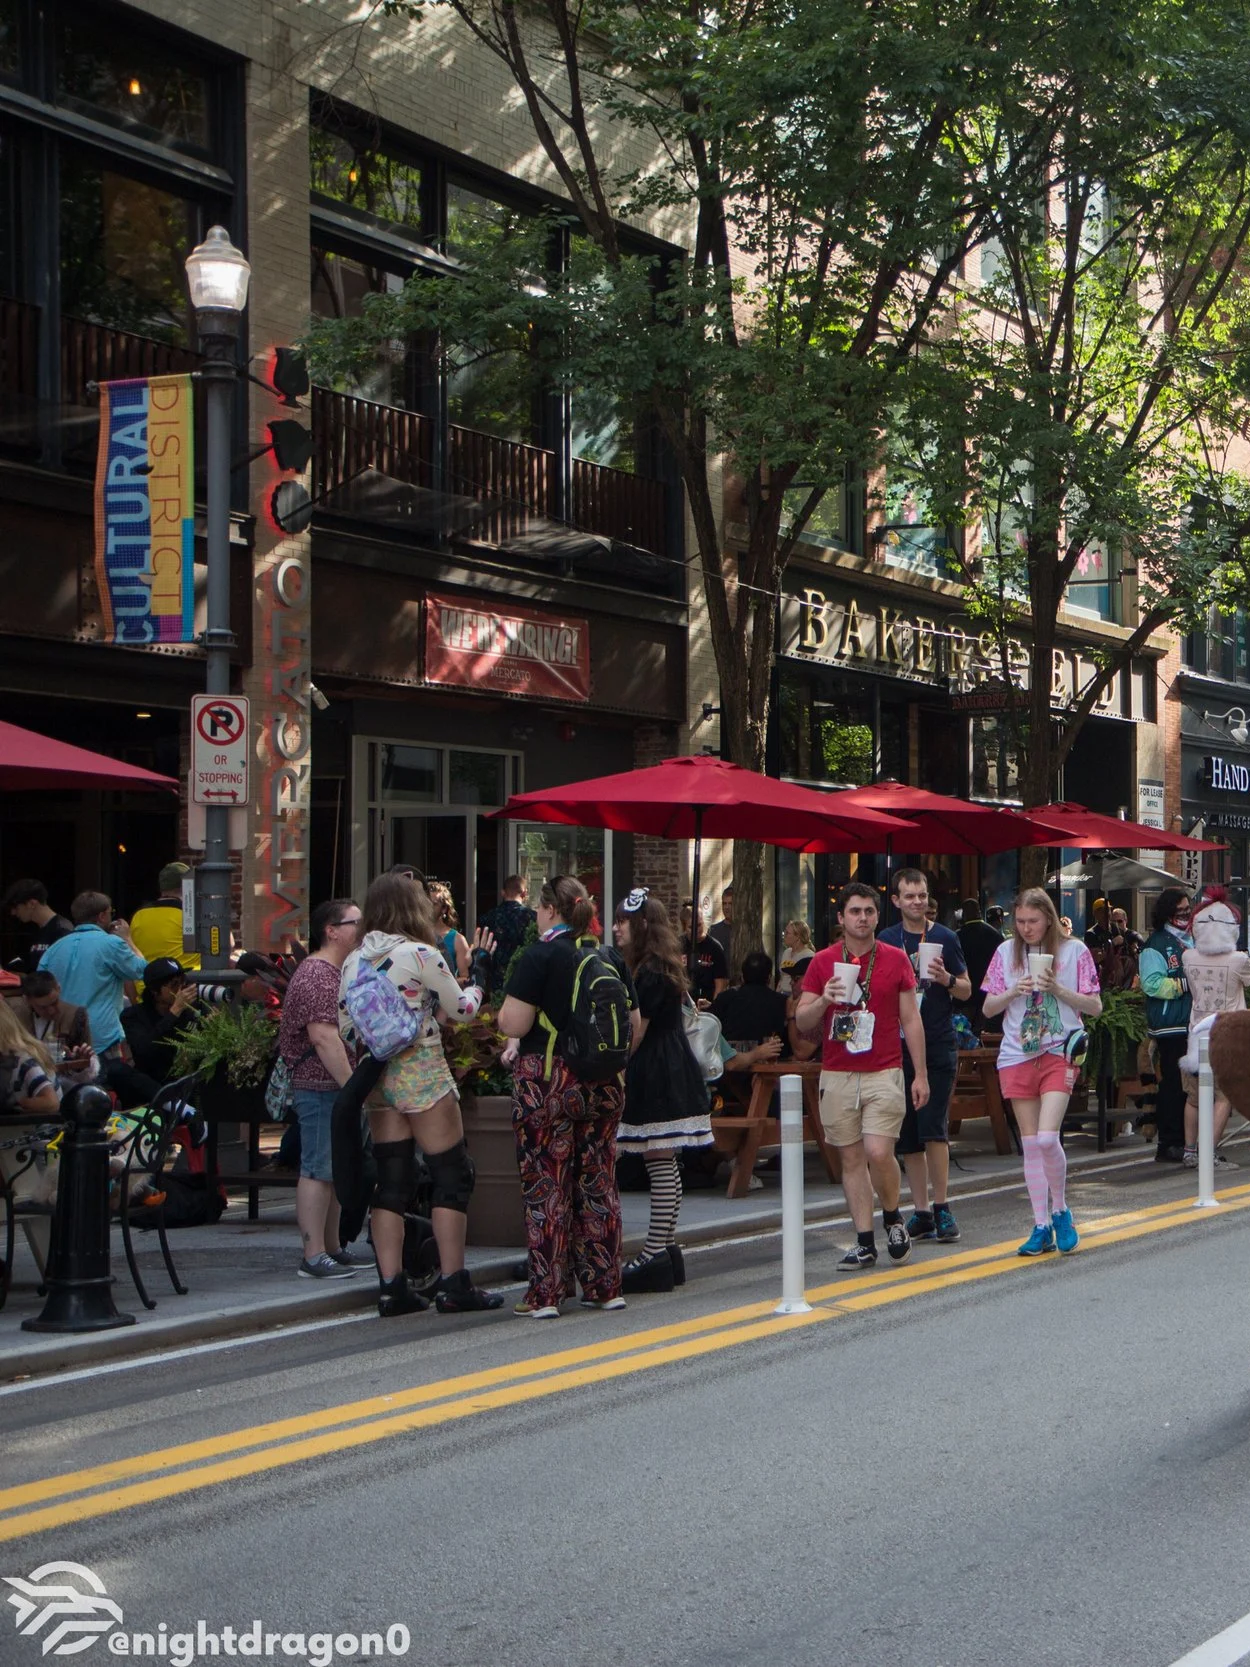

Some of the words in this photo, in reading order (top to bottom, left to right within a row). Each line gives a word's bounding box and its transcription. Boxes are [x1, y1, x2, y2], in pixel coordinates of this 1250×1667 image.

[151, 384, 181, 608] DISTRICT
[107, 387, 153, 643] CULTURAL
[441, 608, 501, 654] WE'RE
[802, 588, 1116, 707] BAKERSELD
[490, 665, 532, 682] MERCATO
[214, 755, 227, 765] OR
[271, 557, 309, 943] MERCATO
[198, 772, 243, 784] STOPPING
[1211, 756, 1249, 792] HAND
[1139, 787, 1150, 797] FOR
[1150, 788, 1163, 798] LEASE
[1218, 813, 1250, 830] MASSAGE
[1186, 850, 1198, 885] OPE
